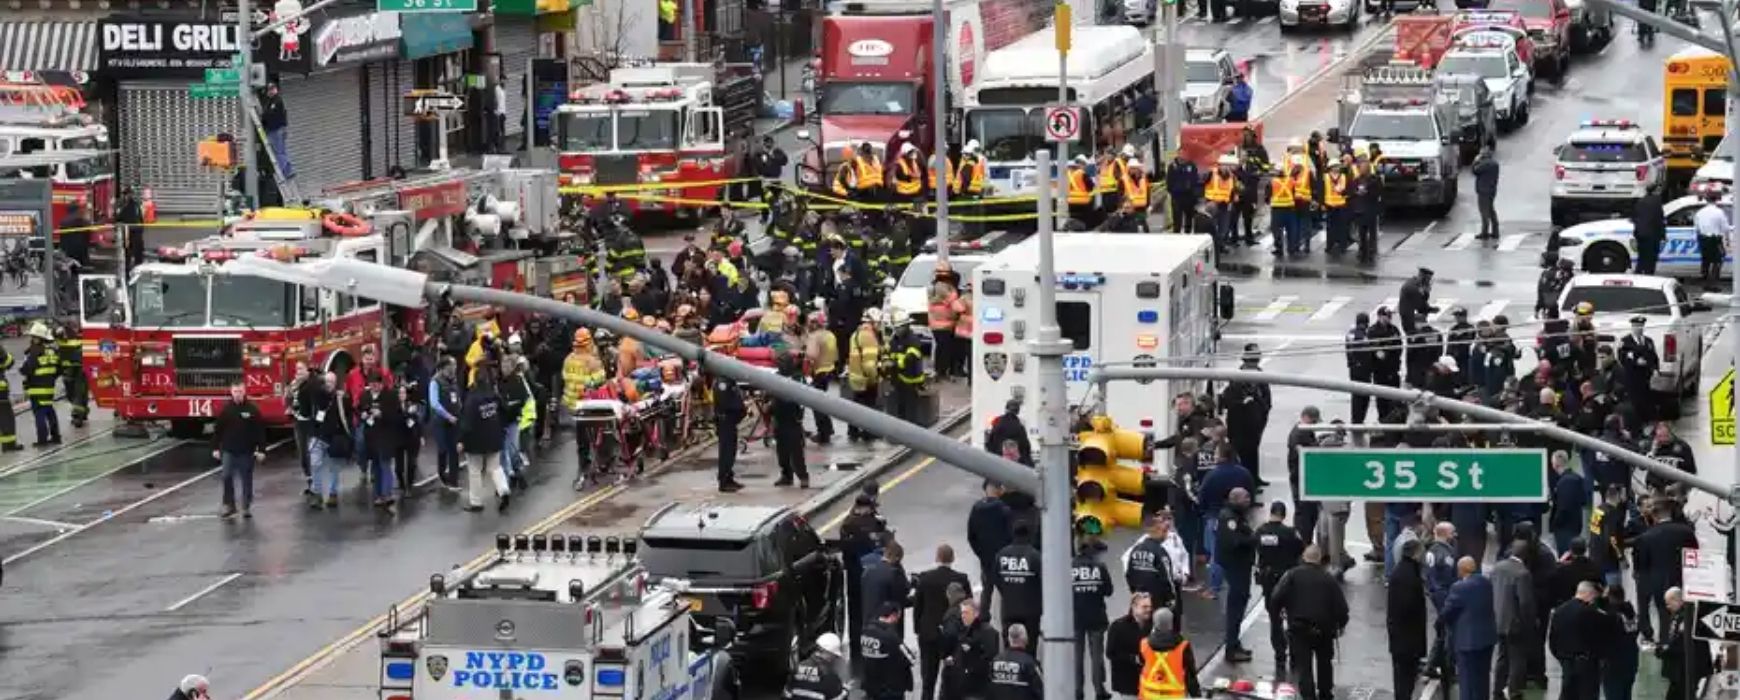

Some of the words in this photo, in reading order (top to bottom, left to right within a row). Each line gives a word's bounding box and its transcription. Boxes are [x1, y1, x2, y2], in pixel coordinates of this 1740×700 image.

[103, 24, 163, 50] DELI
[1062, 356, 1092, 368] YPD
[1064, 370, 1089, 381] LIC
[188, 399, 213, 417] 114
[1363, 460, 1418, 490] 35
[1436, 460, 1484, 490] St
[1000, 556, 1029, 570] PBA
[1071, 567, 1101, 580] PBA
[465, 651, 546, 671] NYPD
[453, 670, 559, 690] POLICE
